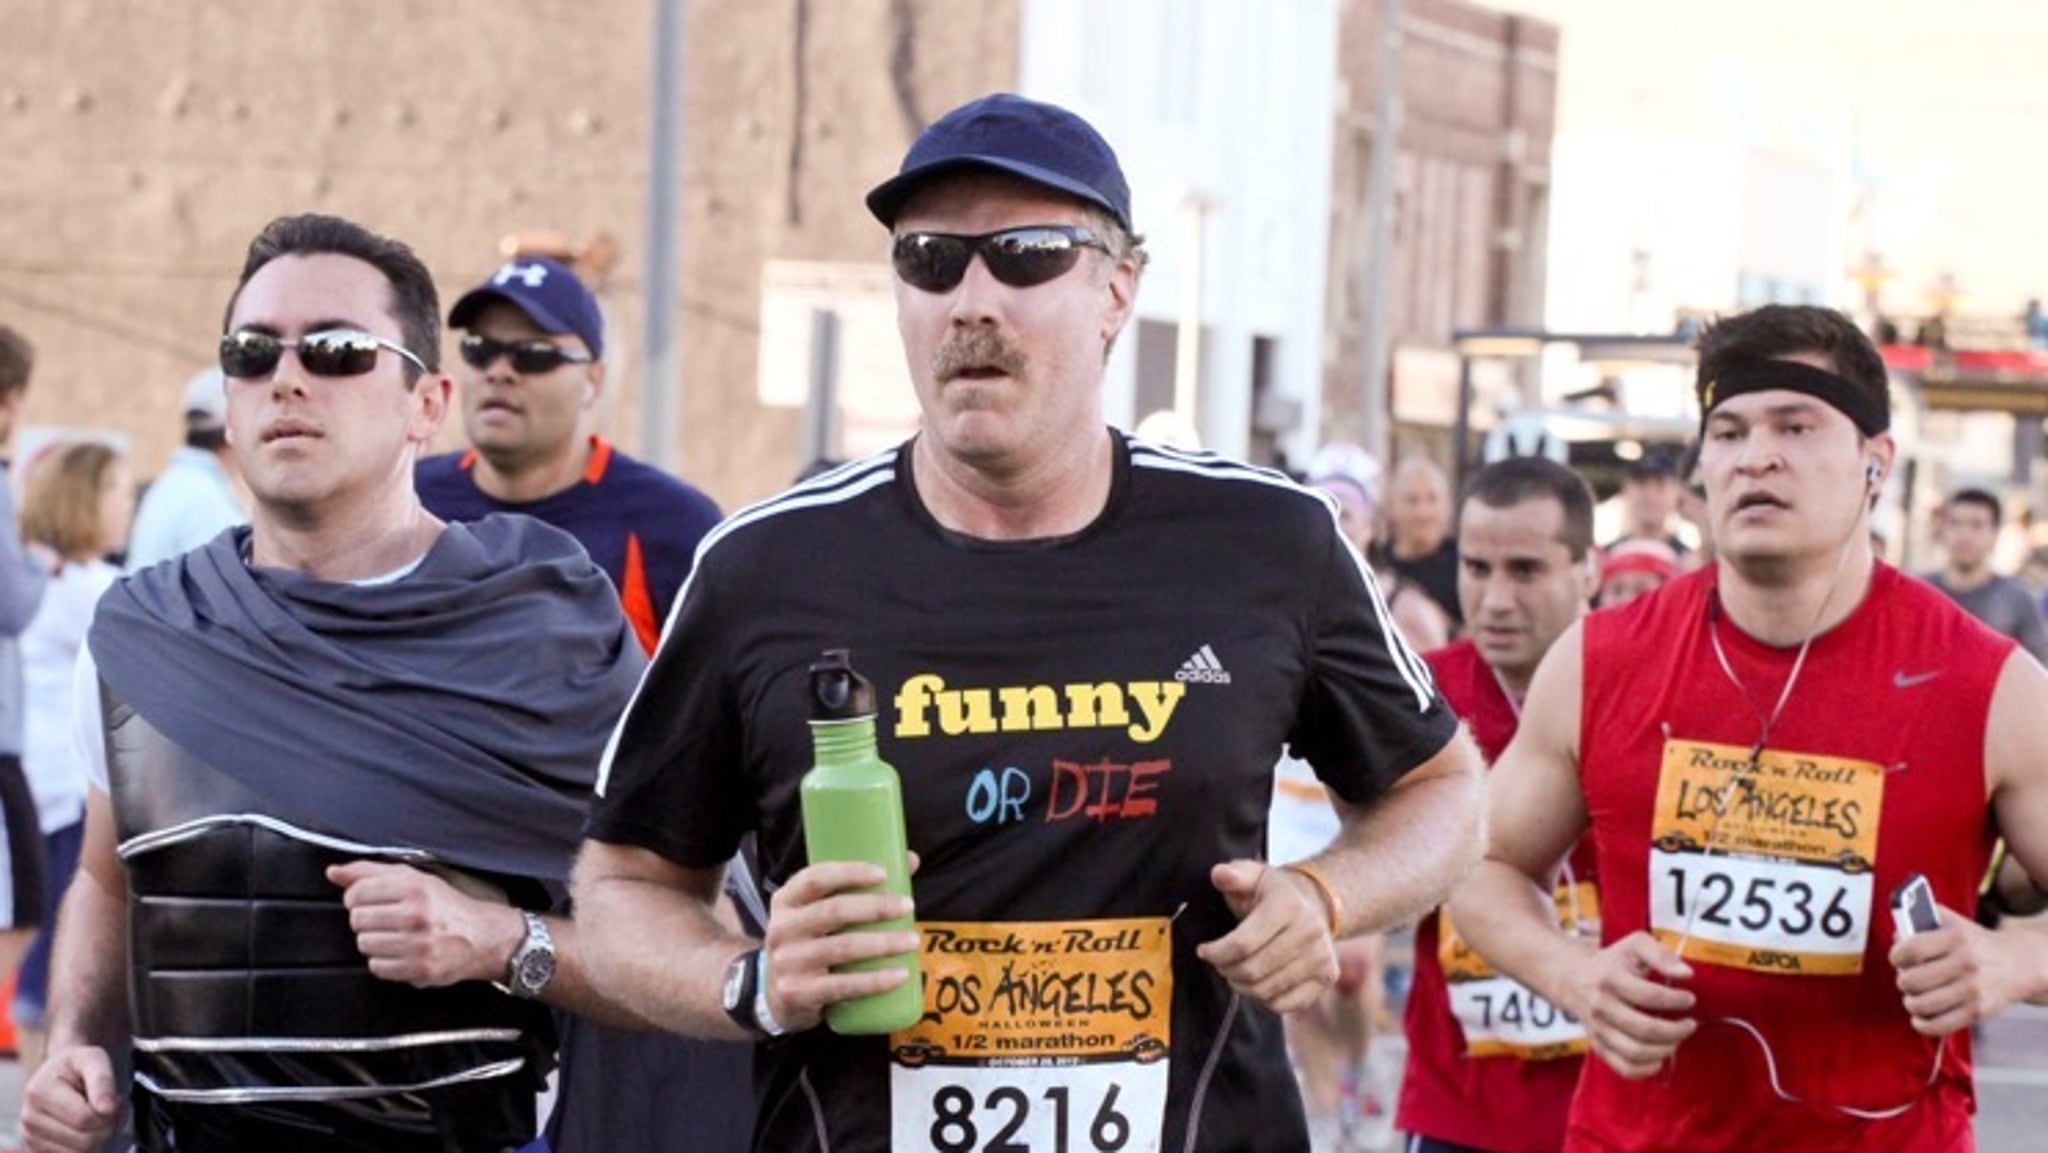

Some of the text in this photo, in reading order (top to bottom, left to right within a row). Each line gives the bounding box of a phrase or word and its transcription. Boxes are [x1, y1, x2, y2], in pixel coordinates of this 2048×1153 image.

[1174, 669, 1232, 684] adidas
[894, 673, 1186, 742] funny
[965, 757, 1172, 824] OR DIE
[1690, 749, 1762, 774] Rock
[1793, 760, 1857, 784] Roll
[1677, 779, 1862, 839] LOS ANGELES
[1667, 868, 1854, 940] 12536
[923, 929, 1025, 954] Rock
[1062, 929, 1142, 953] Roll
[987, 961, 1155, 1021] ANGELES
[952, 1033, 1116, 1050] 1/2 marathon
[978, 1019, 1091, 1030] HALLOWEEN
[930, 1083, 1130, 1153] 8216
